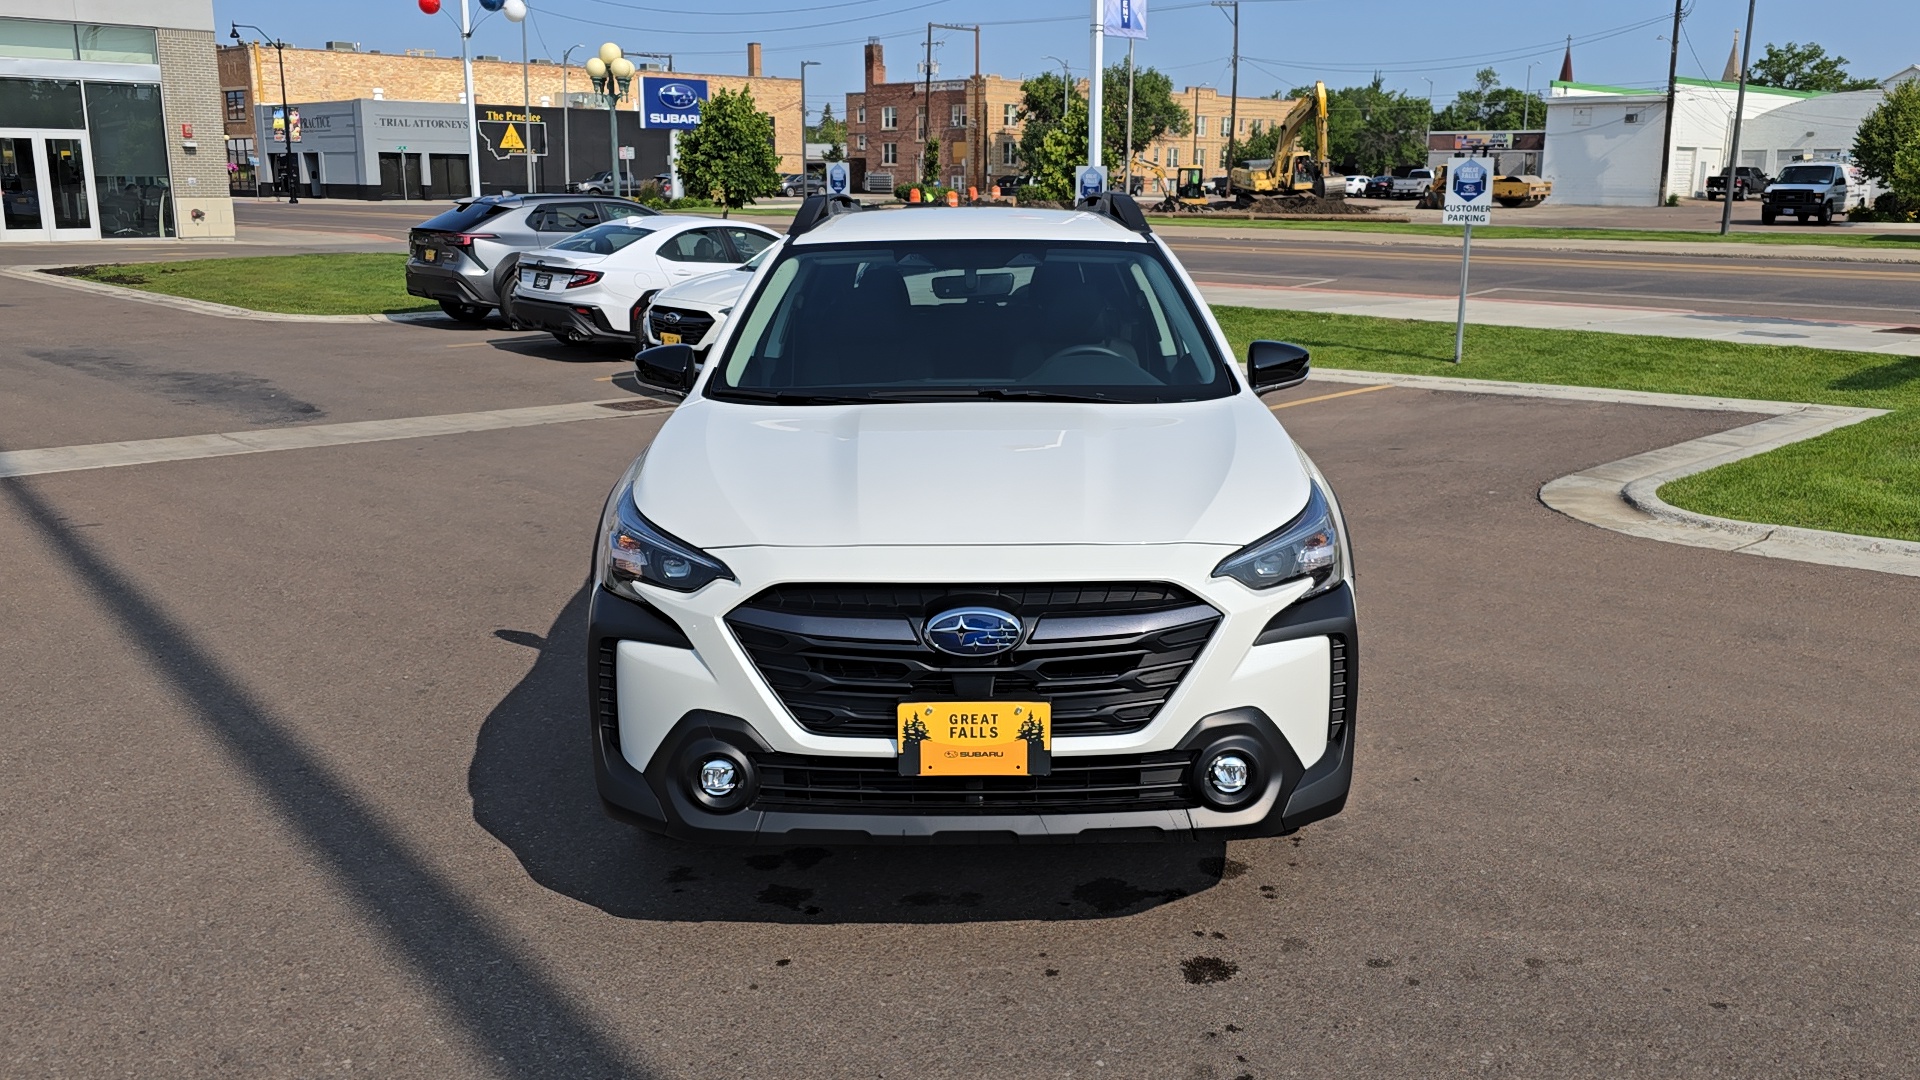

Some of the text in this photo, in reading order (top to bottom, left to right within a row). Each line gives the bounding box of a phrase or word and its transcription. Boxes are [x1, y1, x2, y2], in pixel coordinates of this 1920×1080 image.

[486, 111, 541, 122] The Pracice
[301, 116, 332, 129] PRACTICE
[379, 118, 469, 129] TRIAL ATTORNEYS
[1447, 214, 1486, 222] PARKING
[949, 713, 999, 725] GREAT
[949, 726, 999, 739] FALLS
